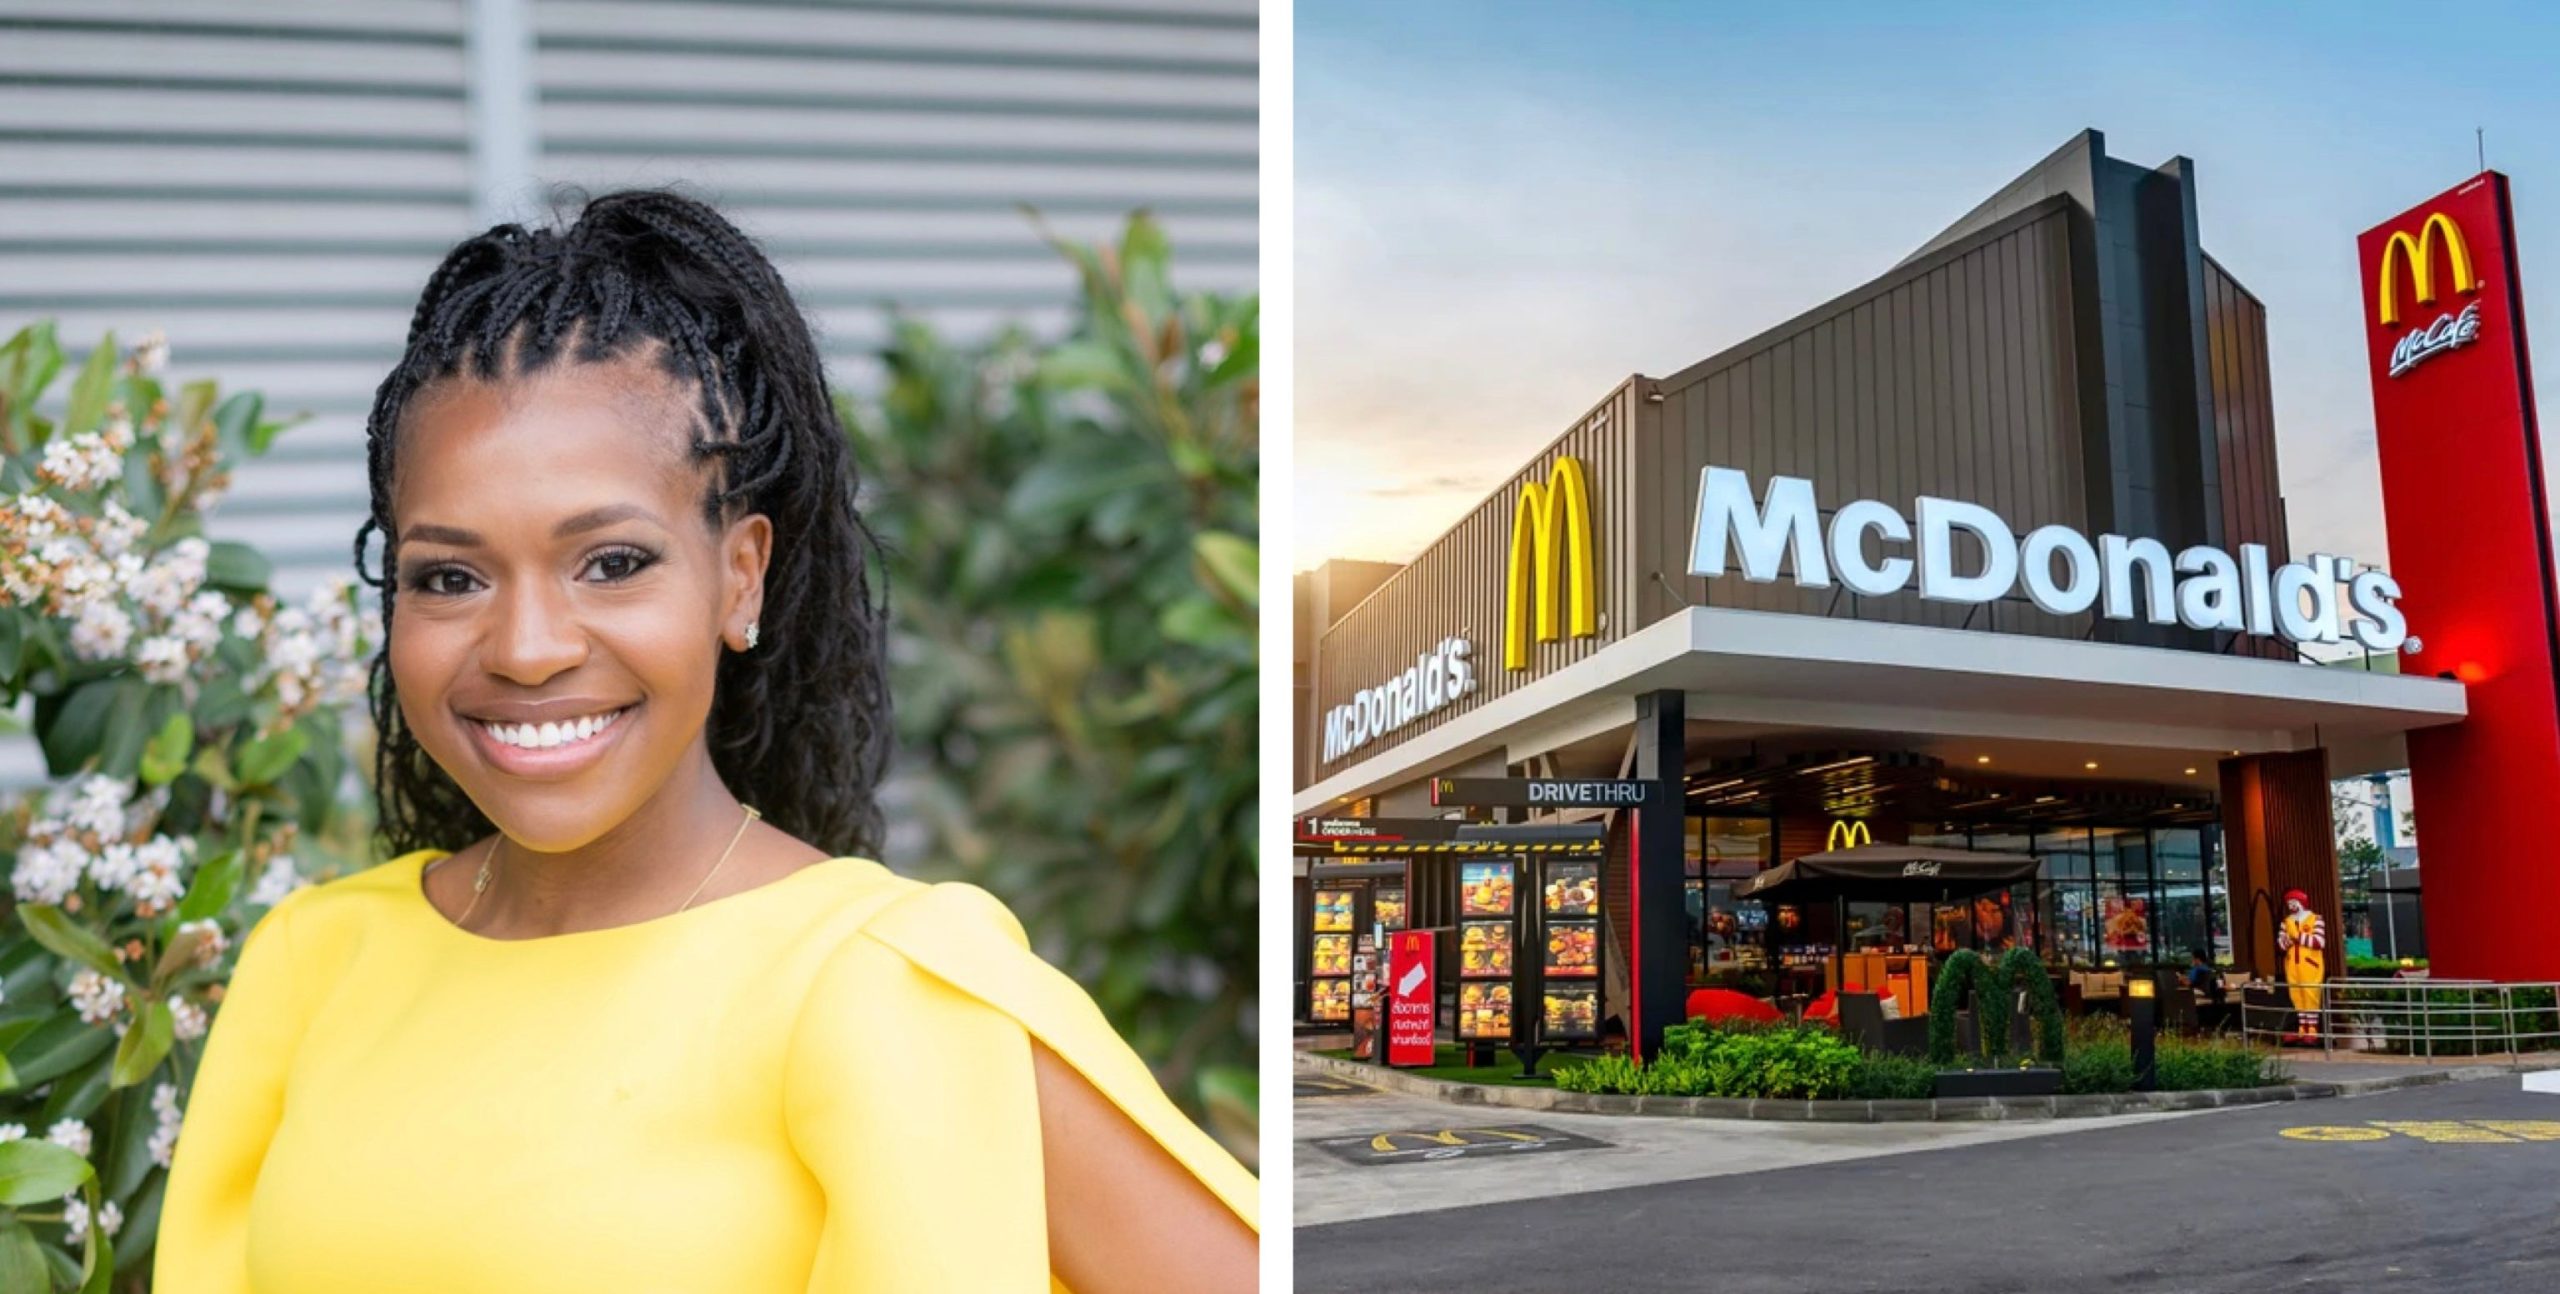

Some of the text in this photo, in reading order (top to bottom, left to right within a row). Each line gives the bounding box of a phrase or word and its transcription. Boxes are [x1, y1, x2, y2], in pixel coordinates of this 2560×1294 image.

[1688, 465, 2407, 651] McDonald's
[1322, 635, 1472, 763] McDonald's
[1308, 817, 1317, 836] 1
